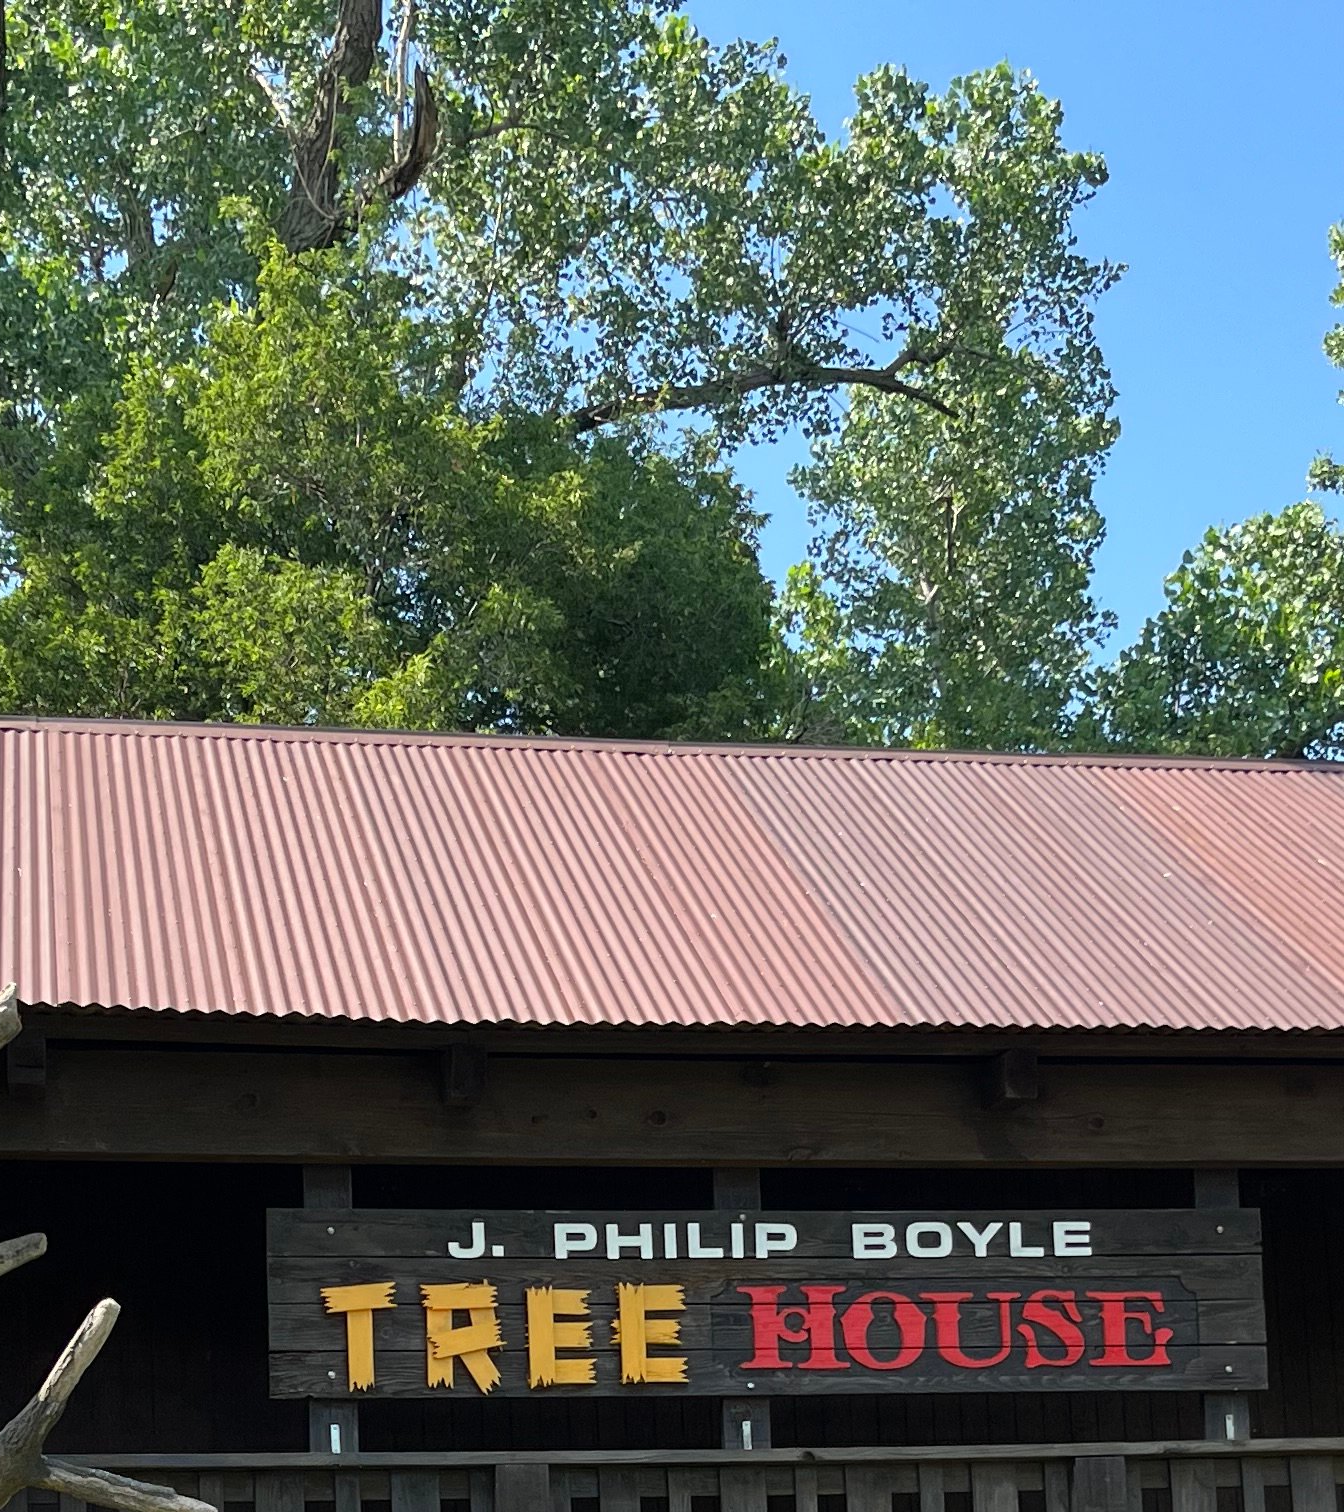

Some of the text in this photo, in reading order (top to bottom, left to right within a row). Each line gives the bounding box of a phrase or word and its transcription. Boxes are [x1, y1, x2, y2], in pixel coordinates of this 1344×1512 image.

[447, 1221, 1094, 1261] J. PHILIP BOYLE
[320, 1280, 1173, 1394] TREE HOUSE
